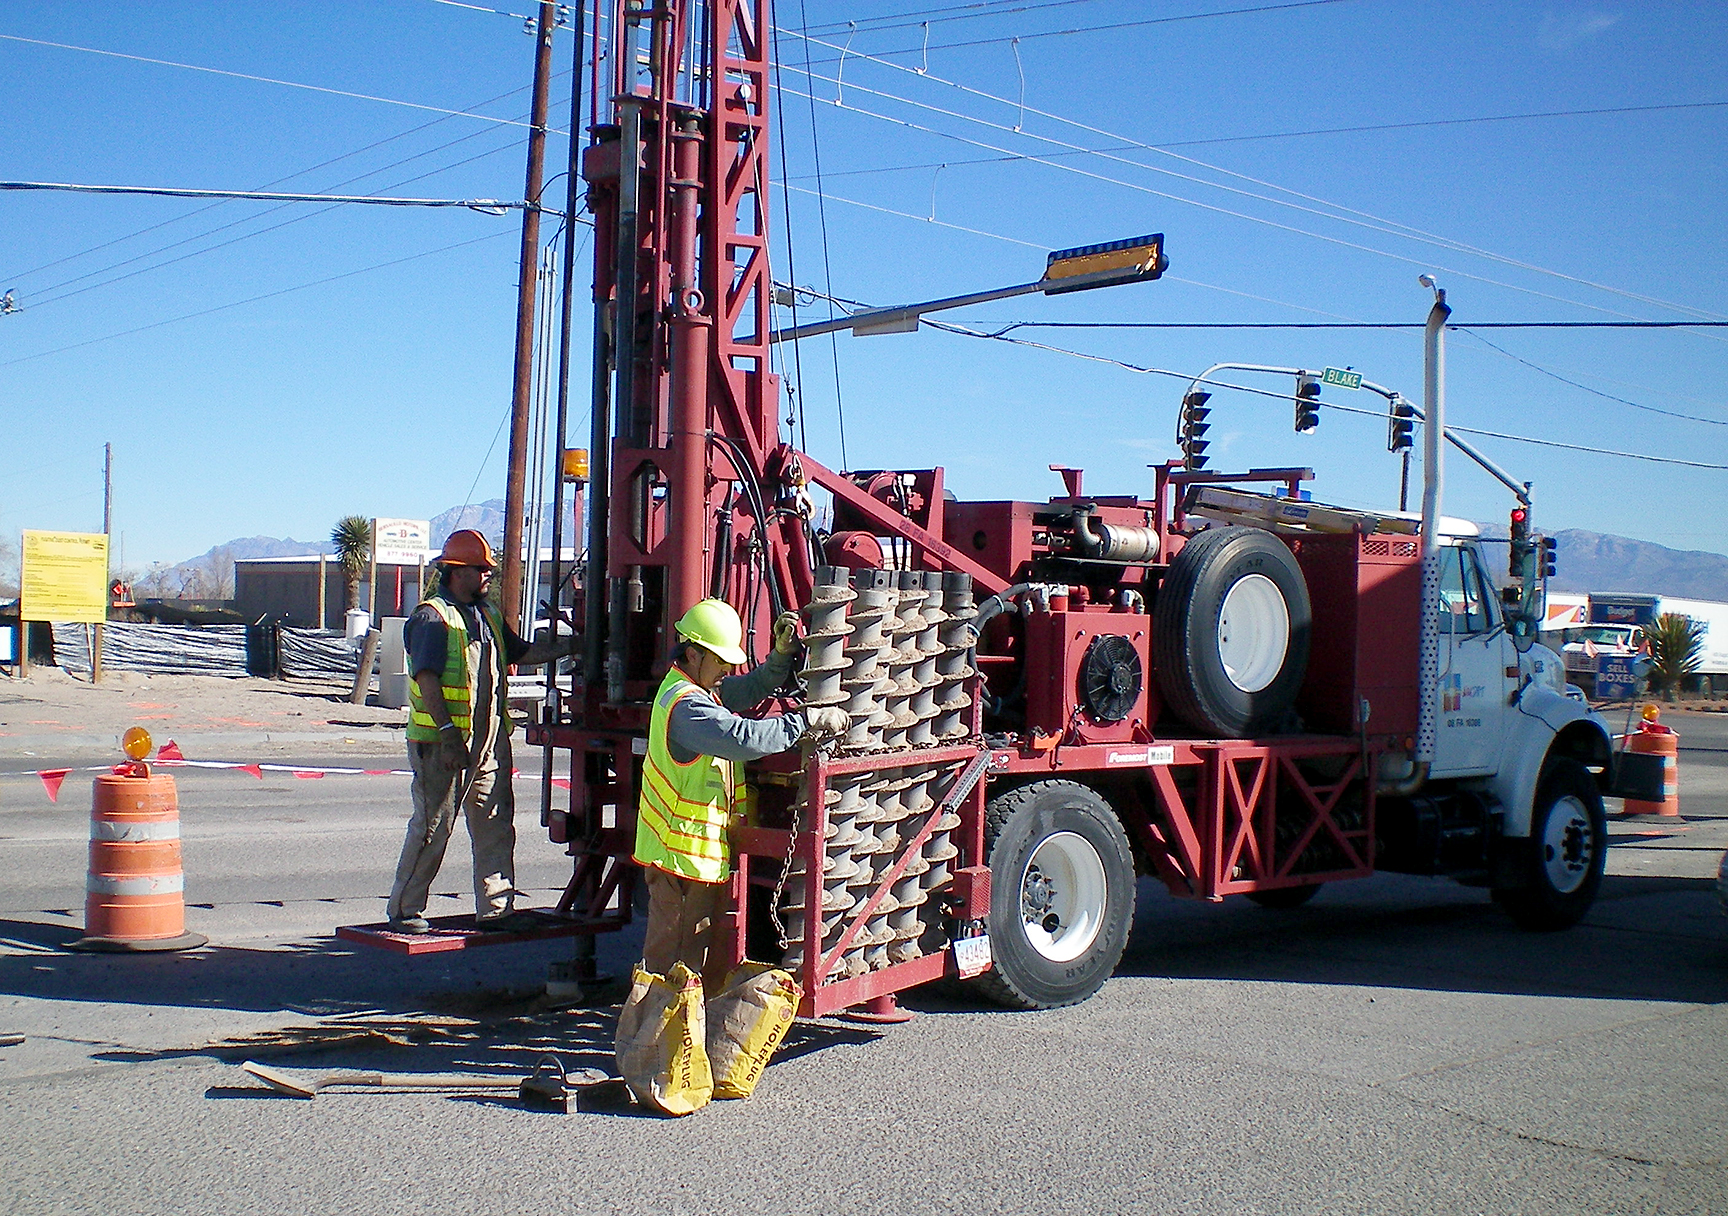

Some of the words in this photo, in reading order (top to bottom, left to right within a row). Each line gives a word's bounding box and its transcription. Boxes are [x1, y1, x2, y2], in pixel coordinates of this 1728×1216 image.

[1327, 370, 1359, 387] BLAKE
[1607, 664, 1628, 673] SELL
[1599, 672, 1636, 684] BOXES
[1151, 751, 1171, 760] Mobile
